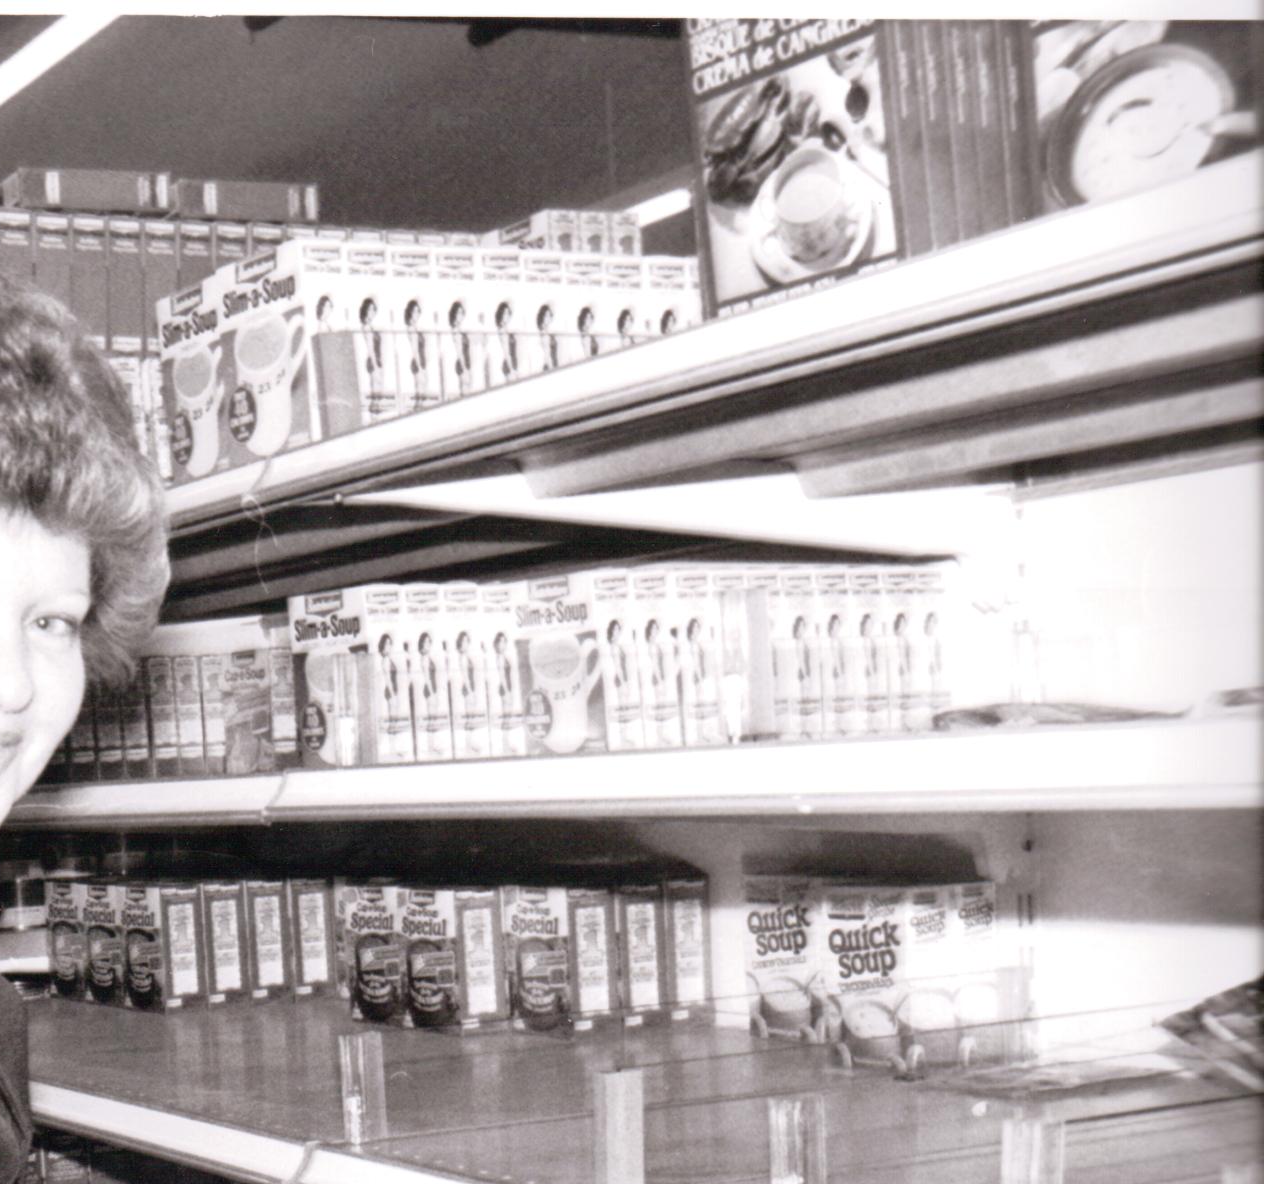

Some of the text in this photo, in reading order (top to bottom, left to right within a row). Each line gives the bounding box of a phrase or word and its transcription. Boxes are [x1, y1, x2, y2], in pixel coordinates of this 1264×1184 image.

[693, 53, 751, 95] CREMA
[752, 46, 775, 71] de
[351, 910, 394, 932] Special
[402, 916, 447, 937] Special
[511, 915, 559, 936] Special
[747, 904, 812, 935] Quick
[756, 926, 808, 957] soup
[828, 920, 901, 954] Quick
[838, 949, 897, 979] soup
